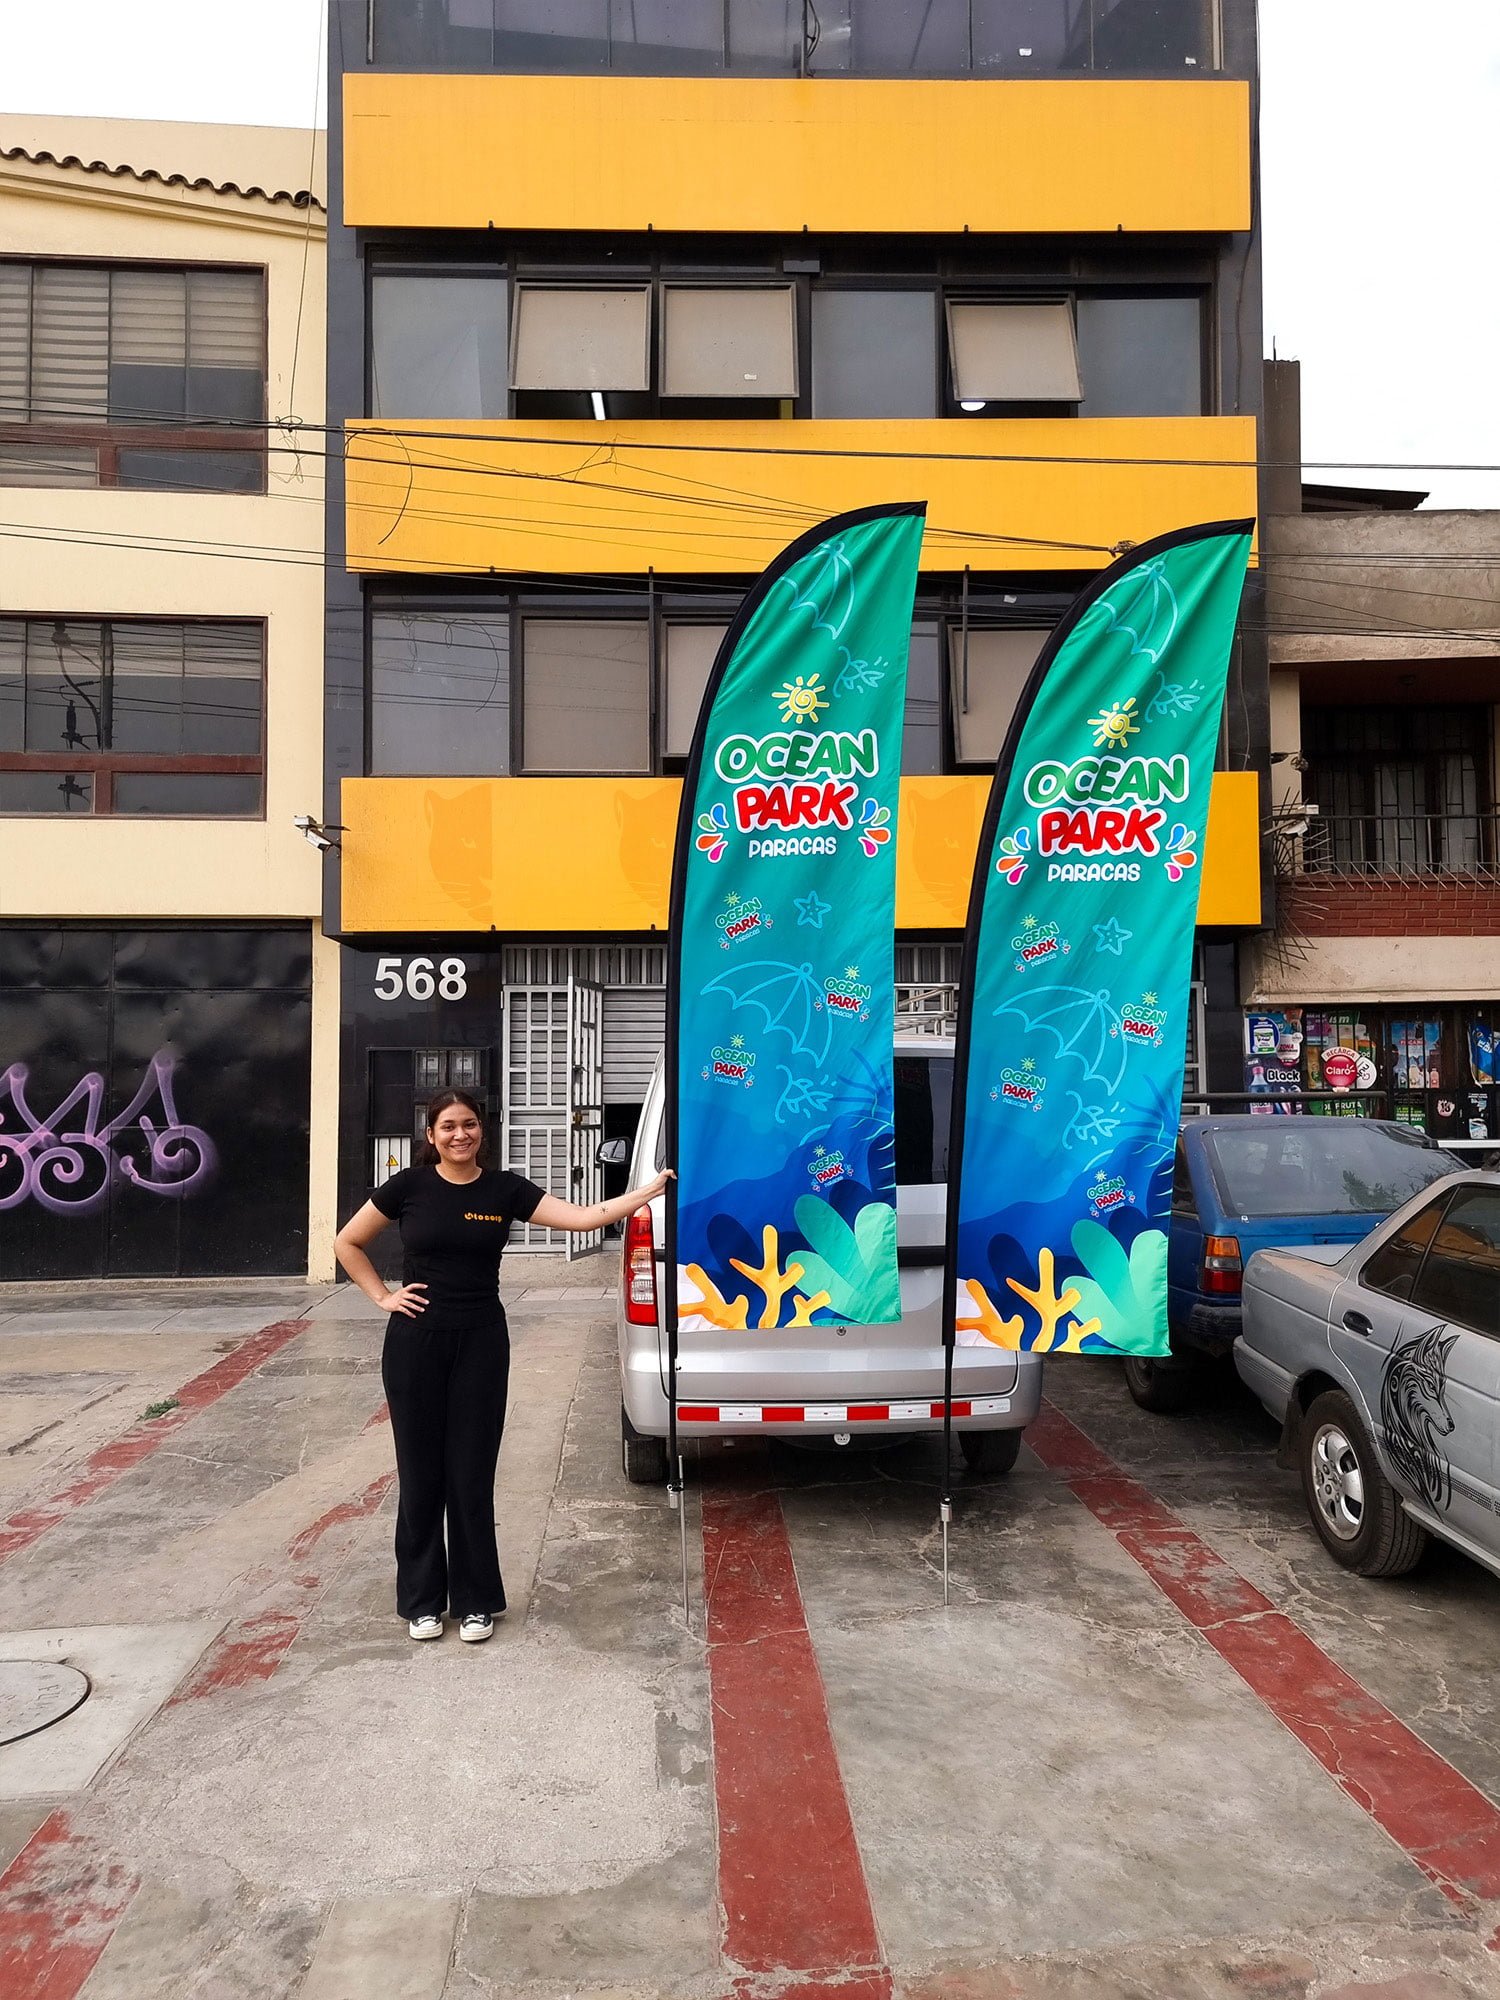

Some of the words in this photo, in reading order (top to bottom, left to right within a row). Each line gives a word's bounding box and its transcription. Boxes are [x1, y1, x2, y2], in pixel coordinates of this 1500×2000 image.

[715, 729, 878, 783] OCEAN
[1024, 754, 1189, 808] OCEAN
[735, 780, 858, 832] PARK
[1038, 805, 1167, 857] PARK
[748, 836, 837, 858] PARACAS
[1048, 862, 1141, 882] PARACAS
[715, 897, 762, 928] OCEAN
[725, 912, 761, 939] PARK
[1011, 921, 1060, 950] OCEAN
[1021, 937, 1058, 962] PARK
[373, 957, 468, 1001] 568
[824, 976, 871, 1000] OCEAN
[827, 992, 863, 1013] PARK
[1121, 1003, 1168, 1025] OCEAN
[1122, 1019, 1159, 1039] PARK
[711, 1046, 756, 1067] OCEAN
[1326, 1047, 1355, 1058] RECARGA
[713, 1061, 748, 1080] PARK
[1000, 1067, 1046, 1091] OCEAN
[1267, 1069, 1300, 1082] Black
[1325, 1066, 1351, 1075] Claro
[1002, 1082, 1037, 1103] PARK
[1335, 1101, 1362, 1109] FRUTA
[808, 1150, 844, 1174] OCEAN
[816, 1163, 844, 1184] PARK
[1087, 1176, 1126, 1200] OCEAN
[1095, 1189, 1126, 1209] PARK
